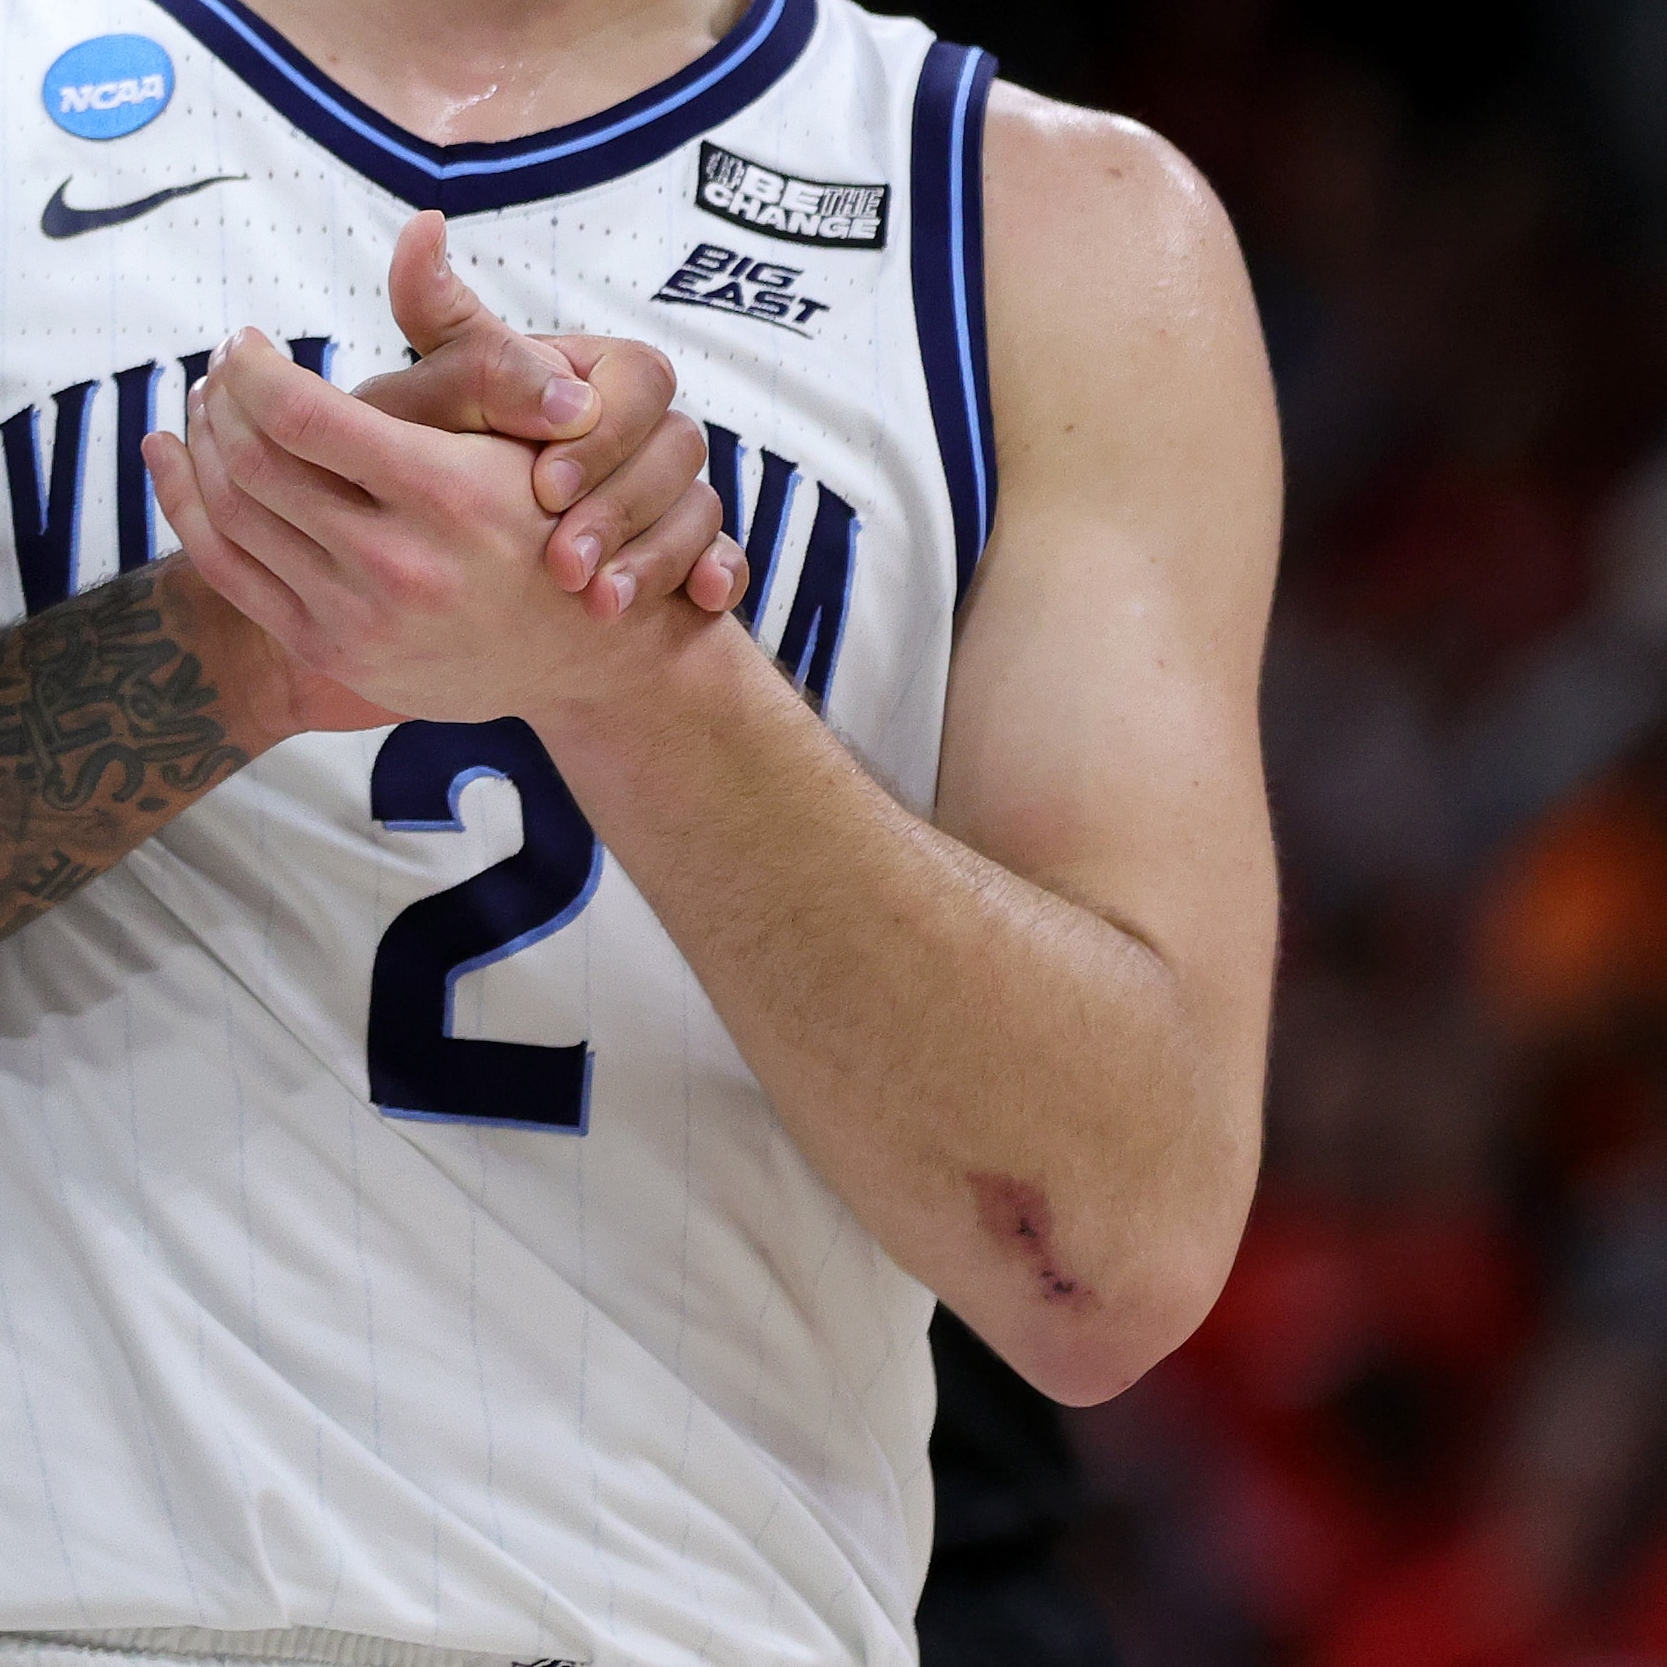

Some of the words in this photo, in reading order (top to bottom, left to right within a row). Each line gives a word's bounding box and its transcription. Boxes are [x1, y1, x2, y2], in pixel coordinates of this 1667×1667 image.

[60, 73, 165, 113] NCAA
[703, 184, 881, 240] CHANGE
[684, 243, 805, 289] BIG
[664, 268, 831, 323] EAST
[367, 716, 605, 1134] 2
